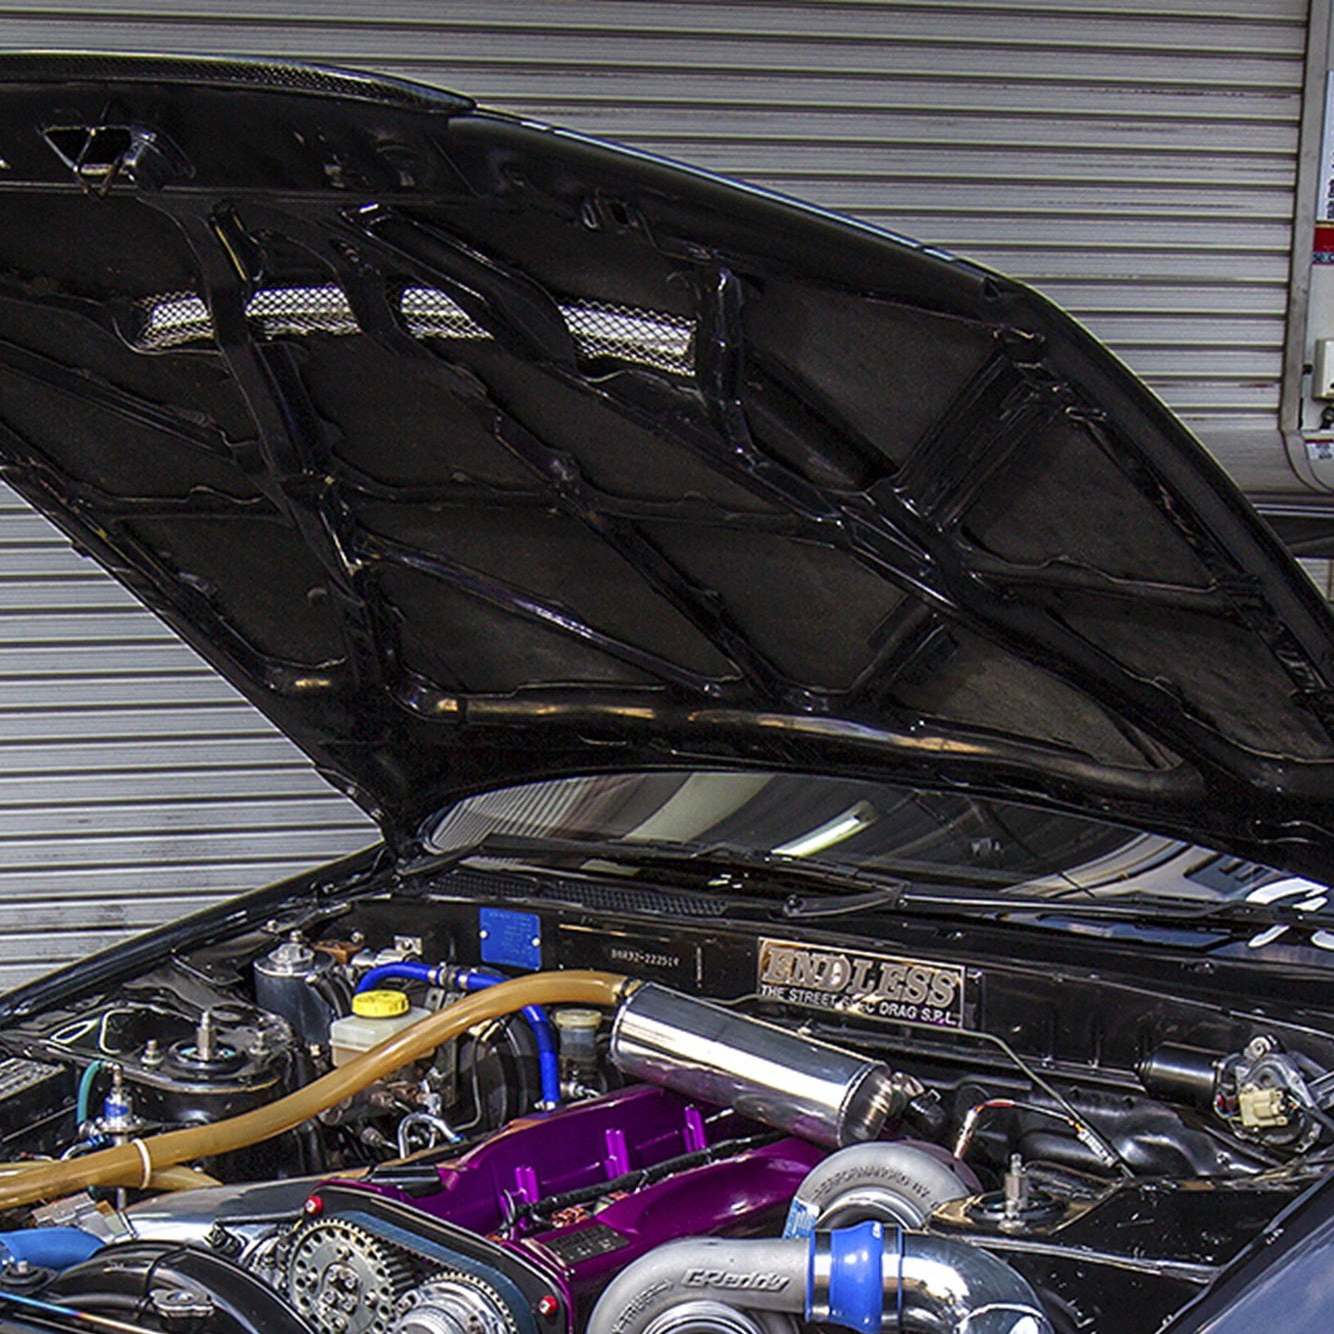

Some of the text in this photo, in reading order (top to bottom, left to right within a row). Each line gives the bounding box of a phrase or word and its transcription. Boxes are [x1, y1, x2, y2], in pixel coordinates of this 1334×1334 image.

[762, 947, 956, 1008] ENDLESS
[761, 984, 785, 1000] THE
[789, 988, 838, 1007] STREET
[839, 993, 875, 1015] SC
[878, 1001, 918, 1020] DRAG
[681, 1267, 791, 1293] GReddy
